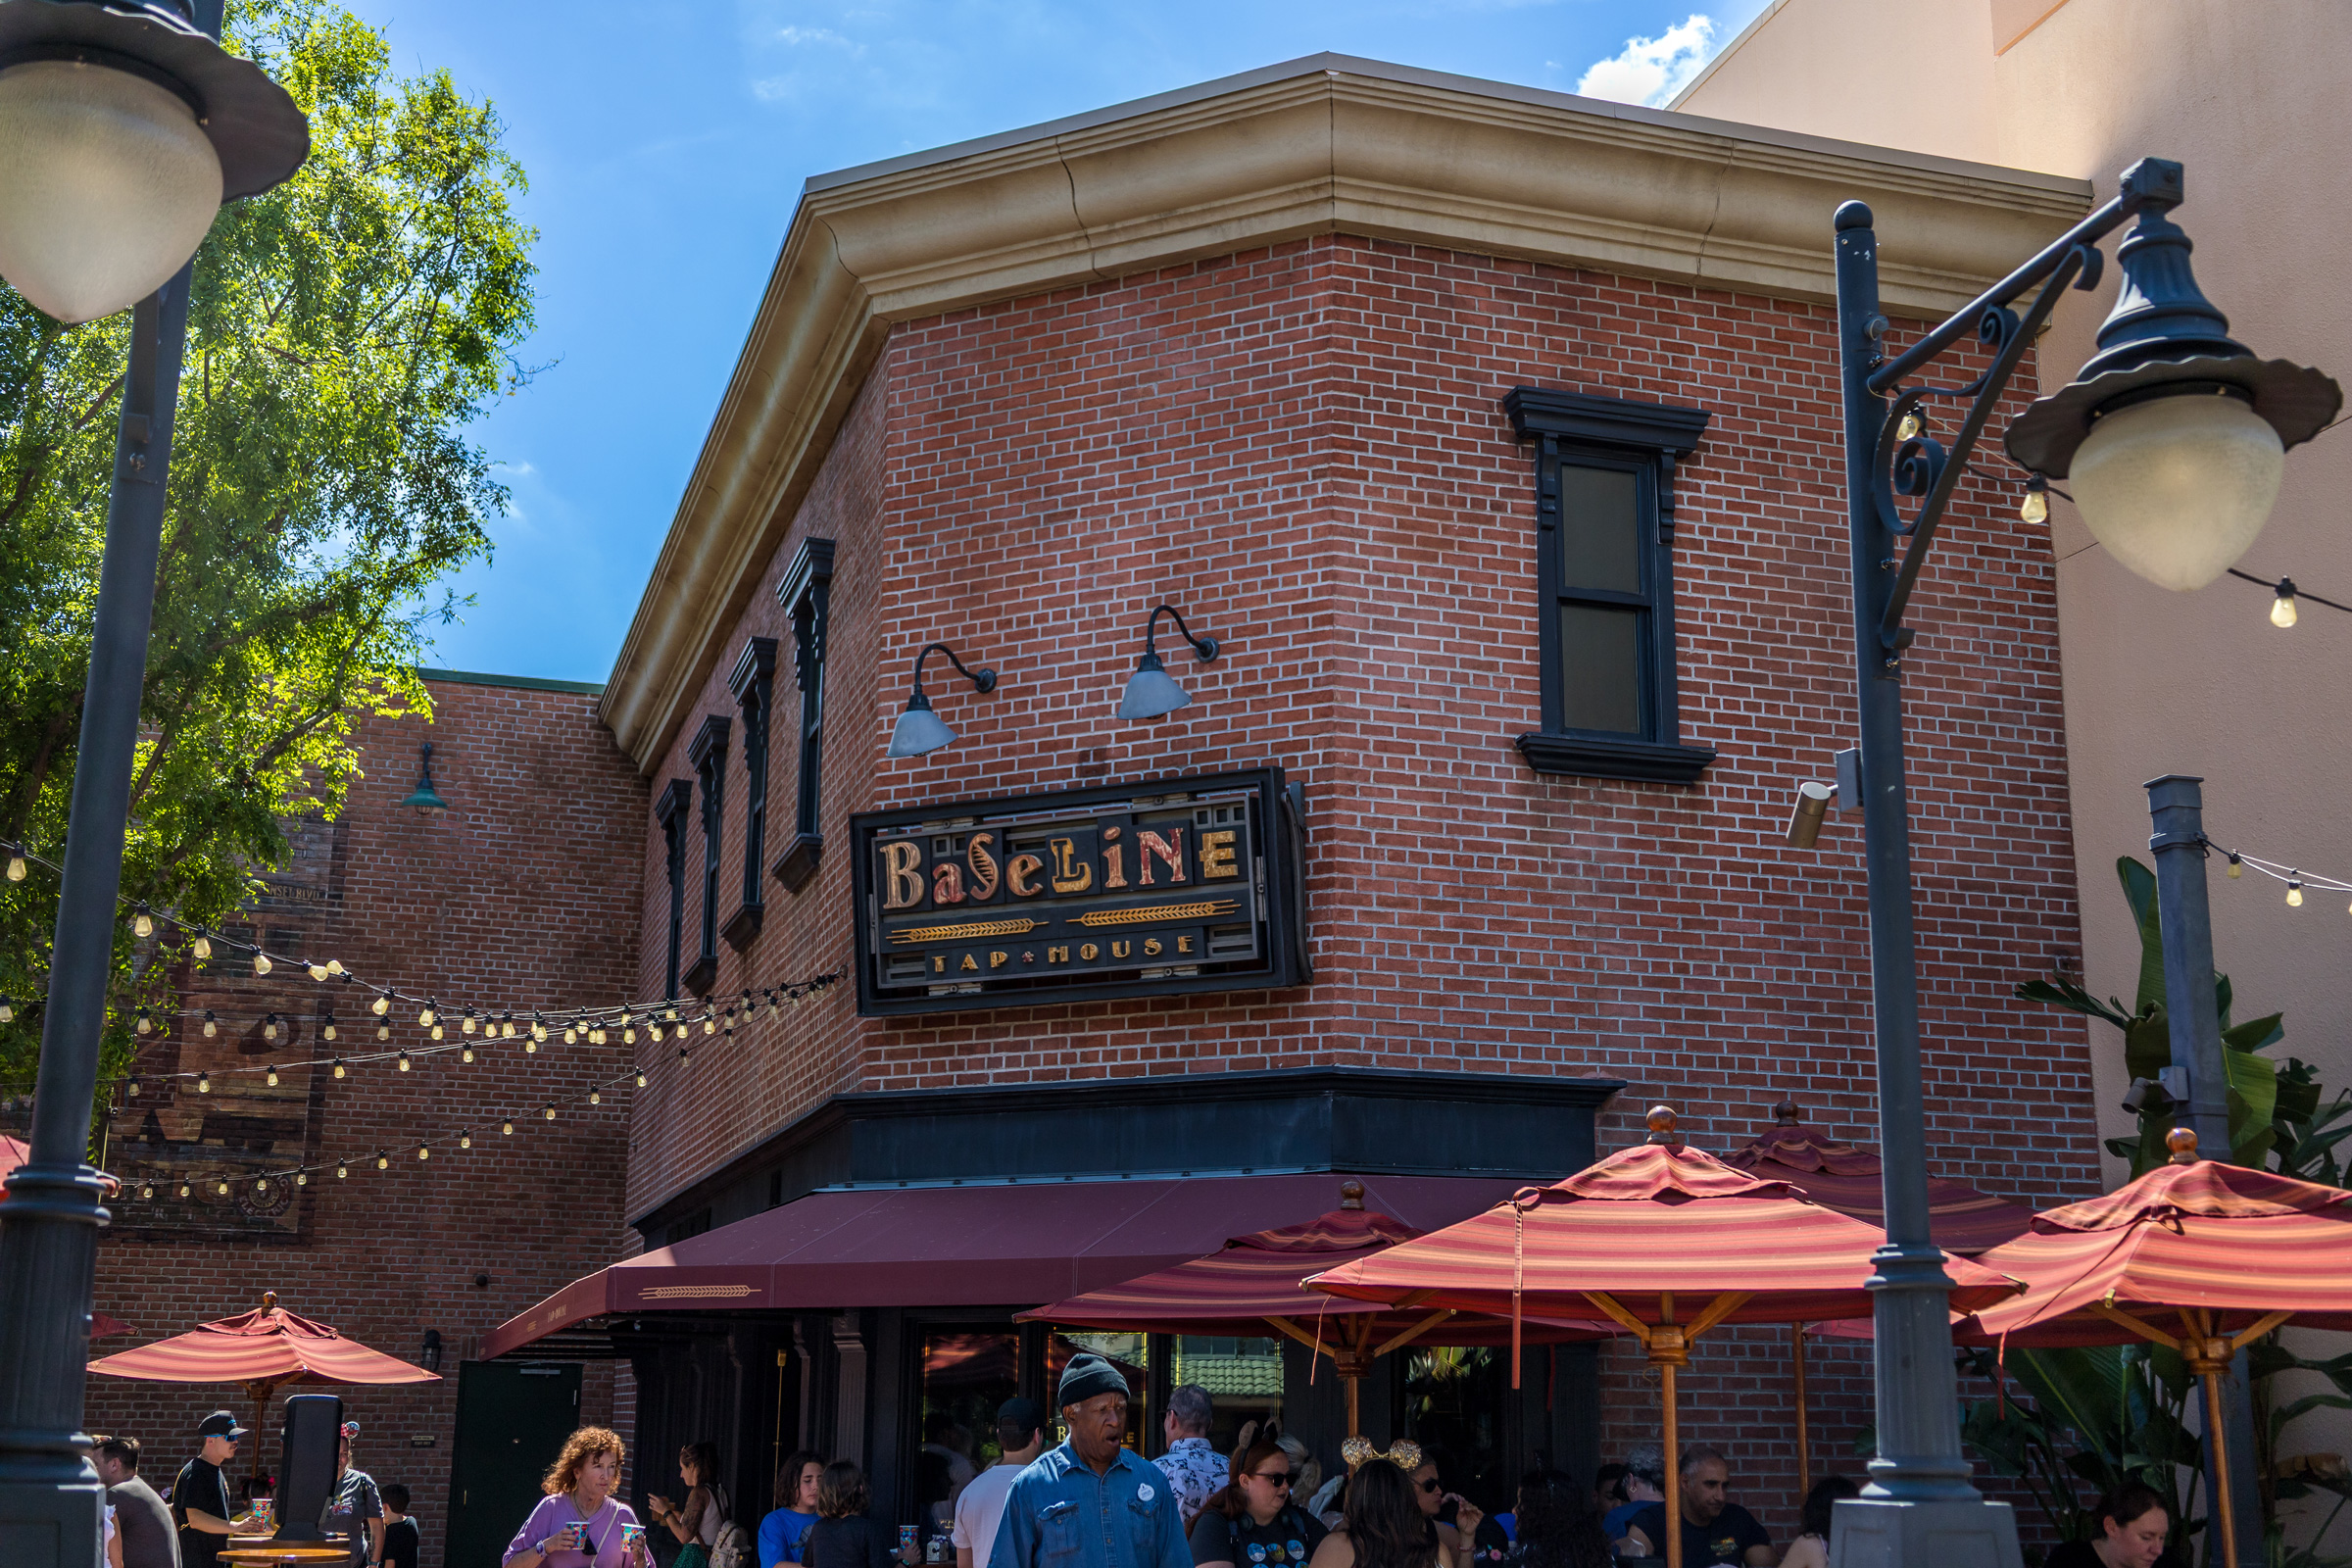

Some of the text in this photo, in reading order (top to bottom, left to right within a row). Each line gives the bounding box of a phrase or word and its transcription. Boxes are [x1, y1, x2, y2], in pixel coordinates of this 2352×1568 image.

[931, 934, 1195, 973] TAP HOUSE
[238, 1195, 289, 1216] ELECTRIC
